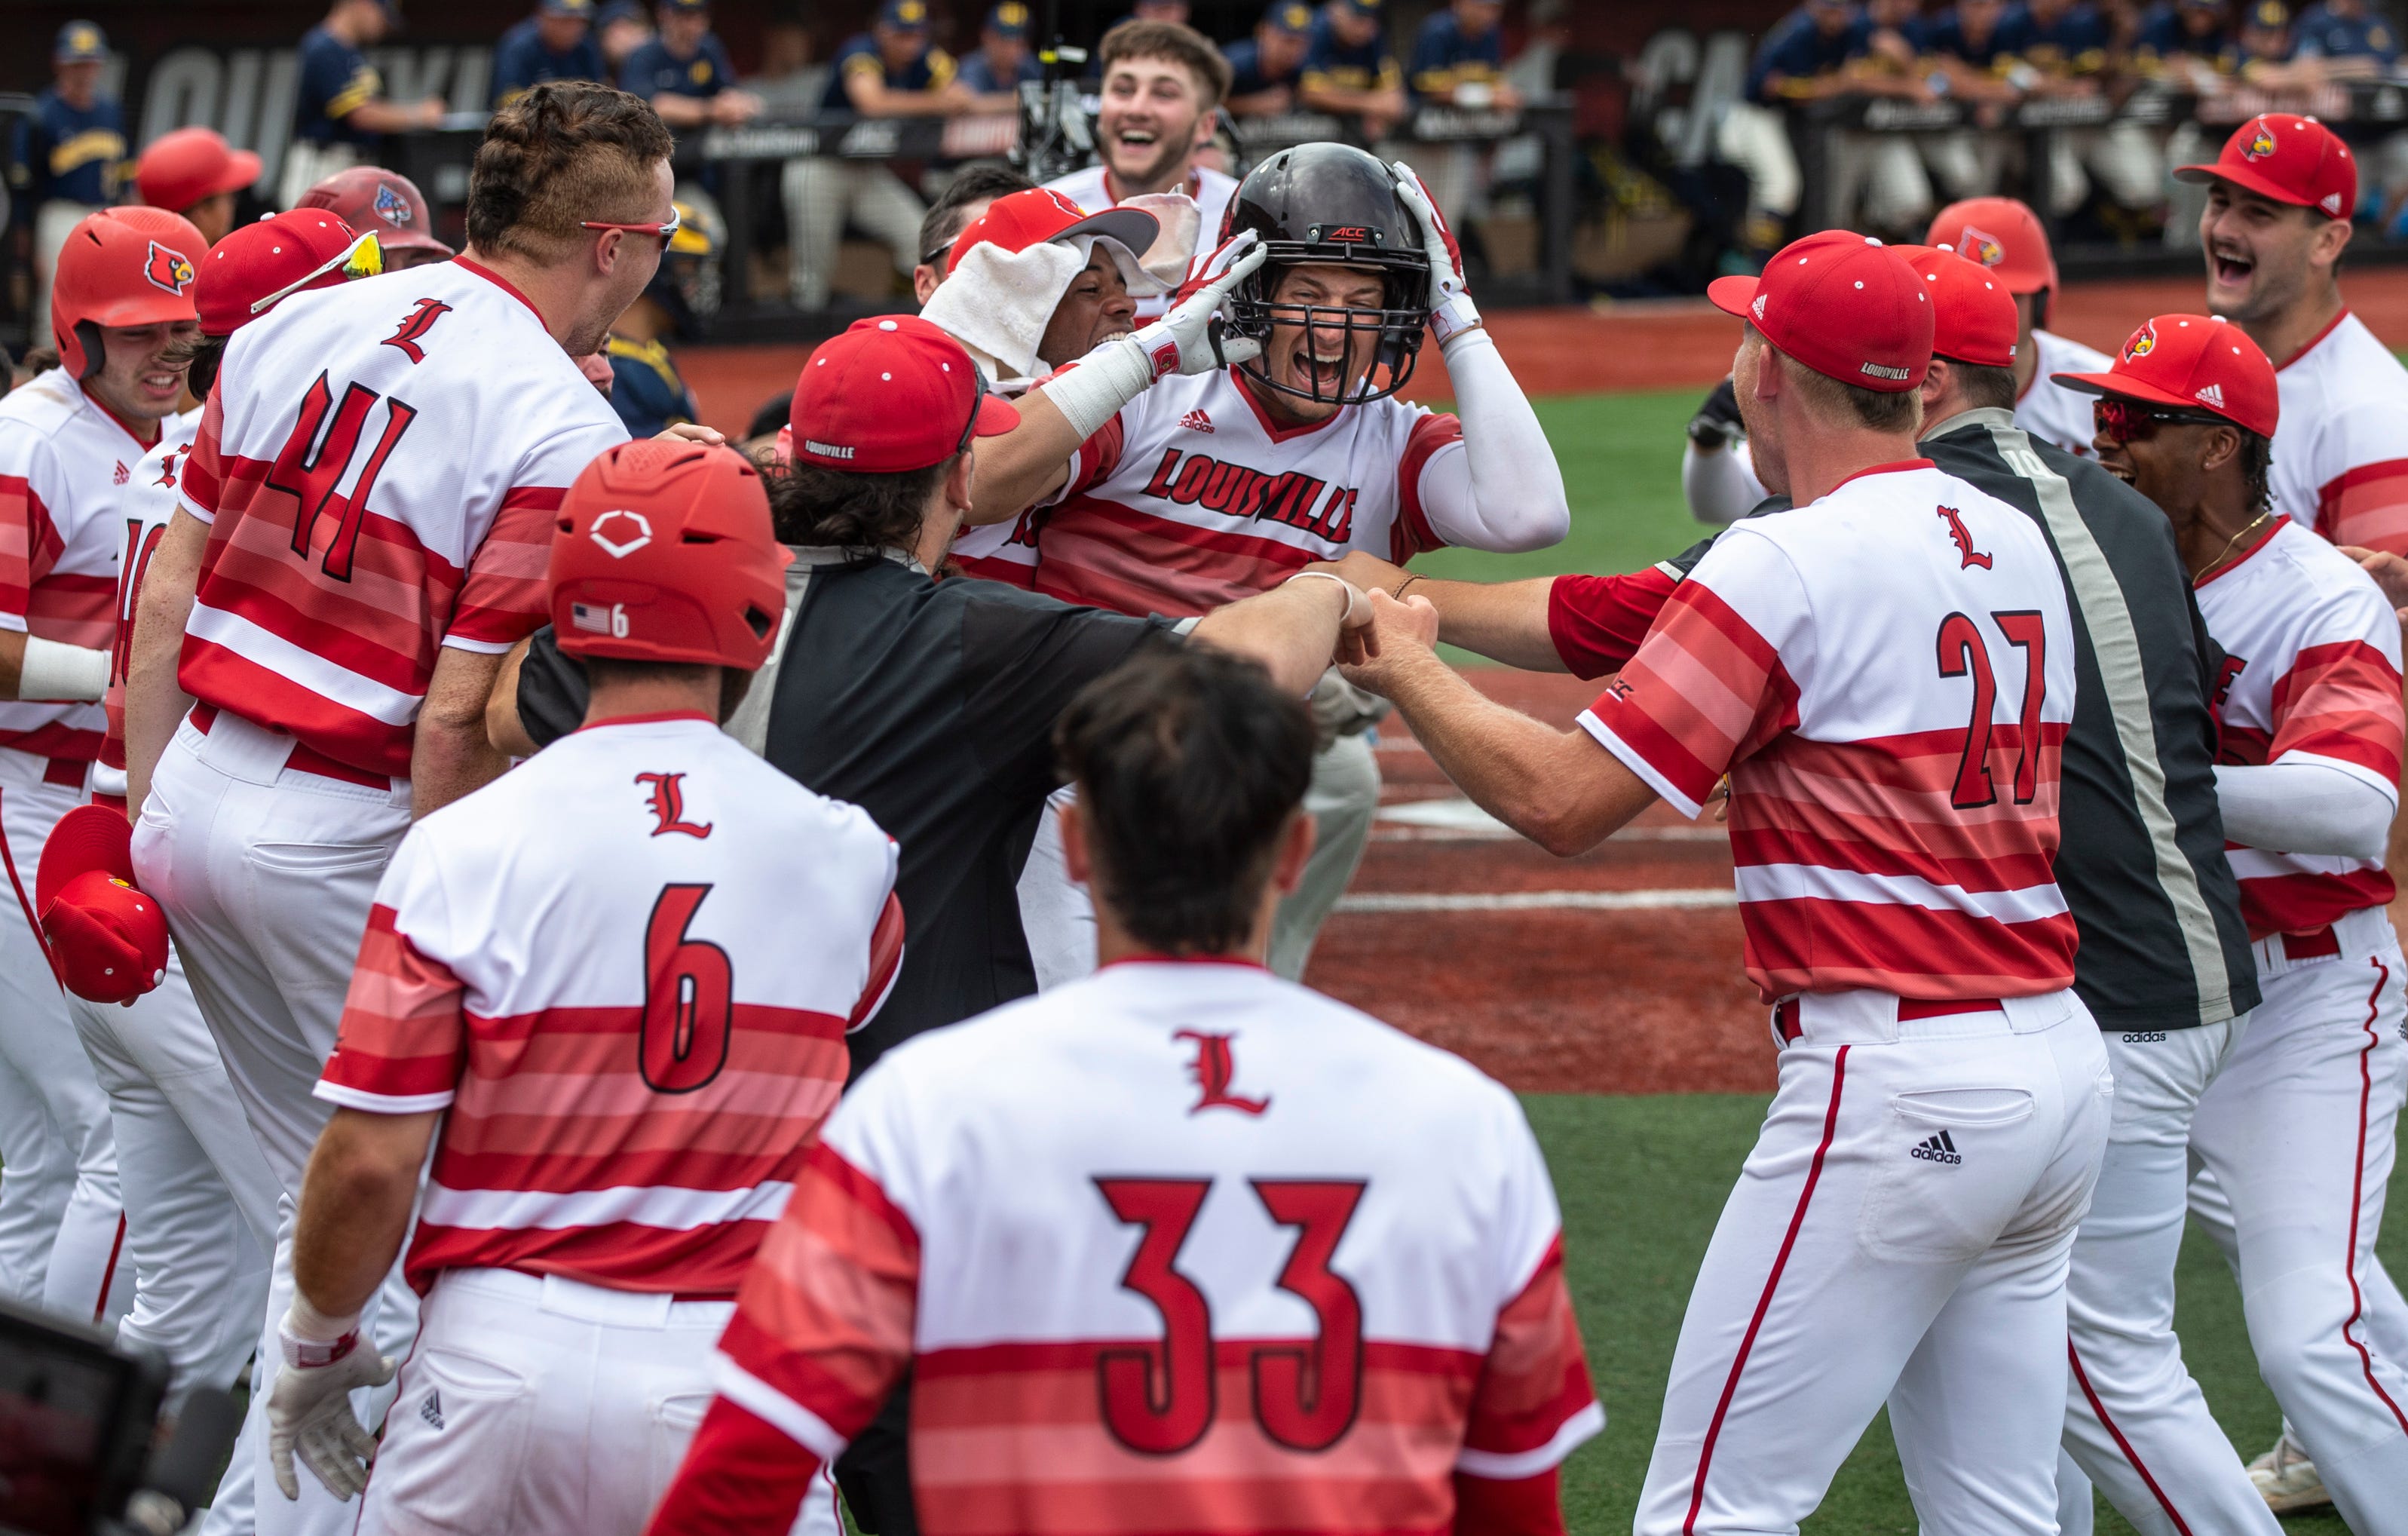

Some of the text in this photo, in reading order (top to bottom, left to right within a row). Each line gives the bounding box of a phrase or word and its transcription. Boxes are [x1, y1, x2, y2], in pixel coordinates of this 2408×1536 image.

[1331, 227, 1366, 238] ACC
[380, 297, 453, 365] L
[1860, 361, 1910, 381] LOUISVILLE
[2195, 391, 2225, 409] adidas
[265, 368, 418, 583] 41
[804, 439, 856, 460] LOUISVILLE
[1138, 447, 1359, 544] LOUISVILLE
[1937, 504, 1993, 570] L
[611, 603, 630, 639] 6
[1936, 609, 2045, 810] 27
[635, 771, 713, 839] L
[639, 881, 733, 1094] 6
[2122, 1030, 2166, 1043] adidas
[1172, 1026, 1274, 1118] L
[1910, 1147, 1962, 1165] adidas
[1089, 1174, 1371, 1458] 33
